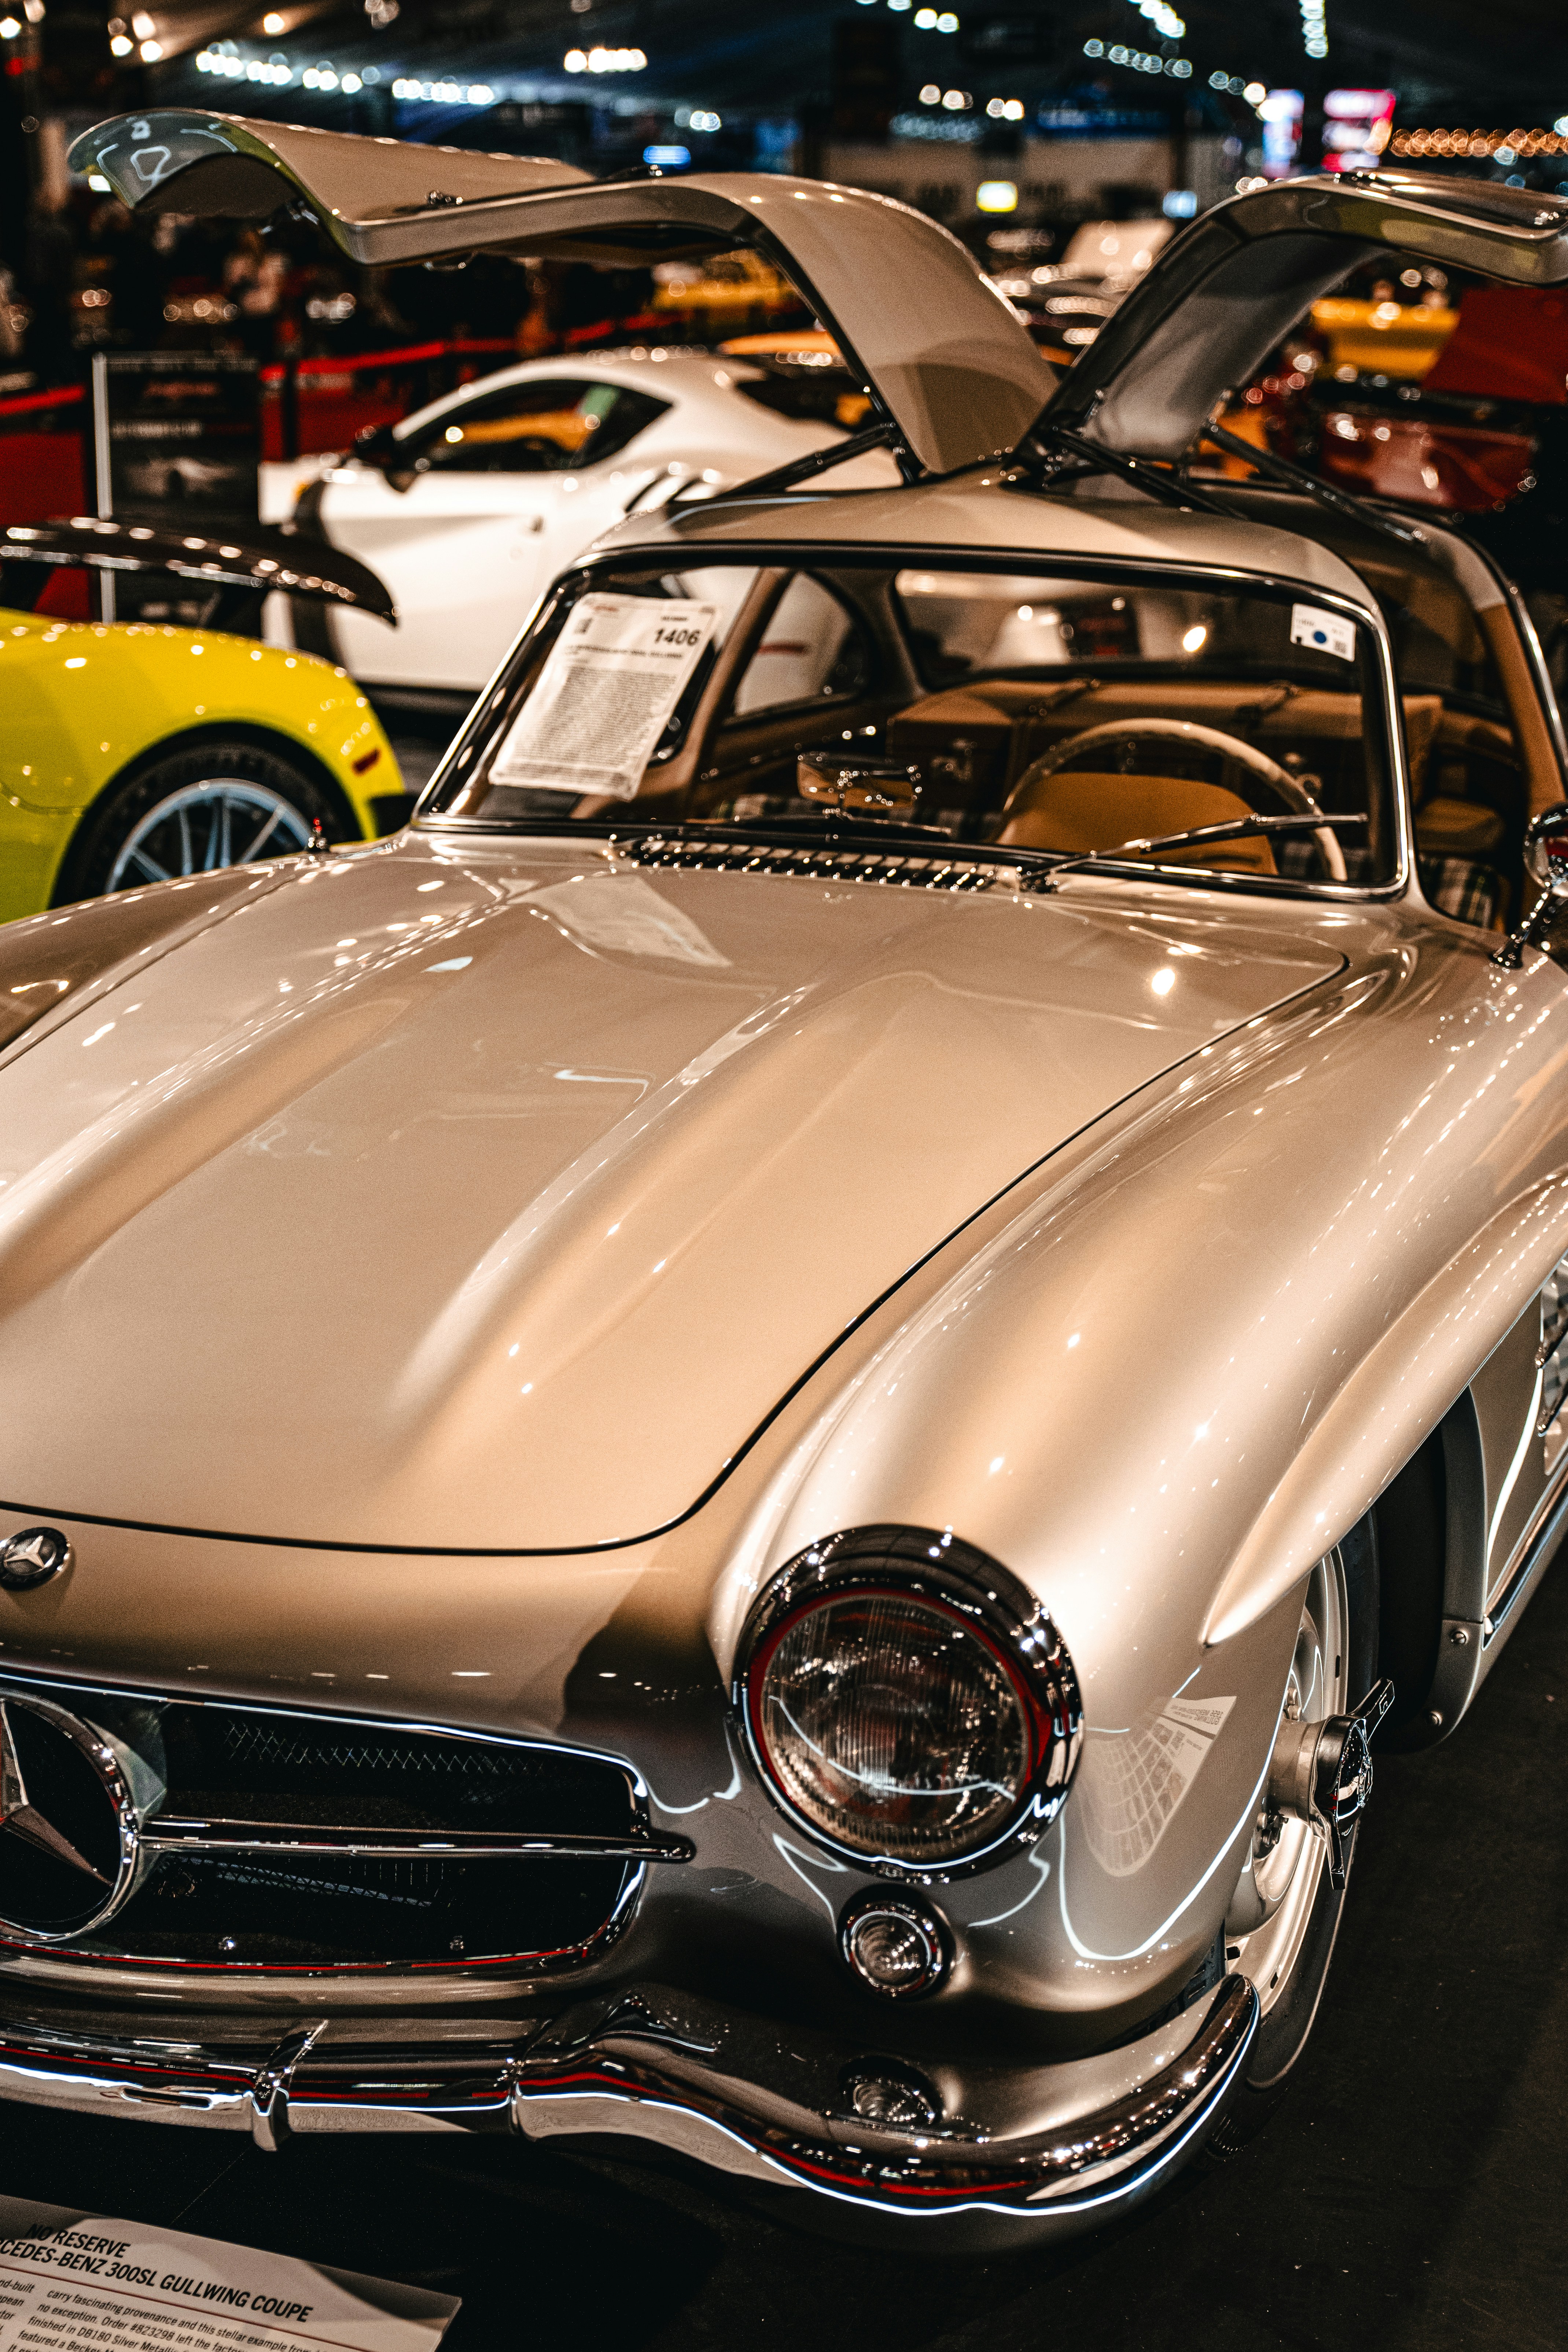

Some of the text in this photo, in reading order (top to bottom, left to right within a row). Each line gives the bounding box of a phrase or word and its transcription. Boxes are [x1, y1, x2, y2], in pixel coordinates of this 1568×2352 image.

[655, 628, 700, 646] 1406
[24, 2224, 131, 2258] NO RESERVE
[104, 2262, 158, 2286] 300SL
[160, 2274, 250, 2308] GULLWING
[251, 2295, 313, 2323] COUPE
[0, 2309, 15, 2320] tor
[37, 2304, 247, 2352] no exception. Order #823298 left the fact
[47, 2290, 73, 2303] carry
[73, 2294, 124, 2315] fascinating
[122, 2307, 178, 2326] provenance
[177, 2320, 199, 2330] and
[197, 2322, 216, 2335] this
[216, 2328, 247, 2342] stellar
[247, 2336, 288, 2352] example
[18, 2329, 60, 2347] featured
[27, 2315, 180, 2352] finished in DB180 Silver Metalli
